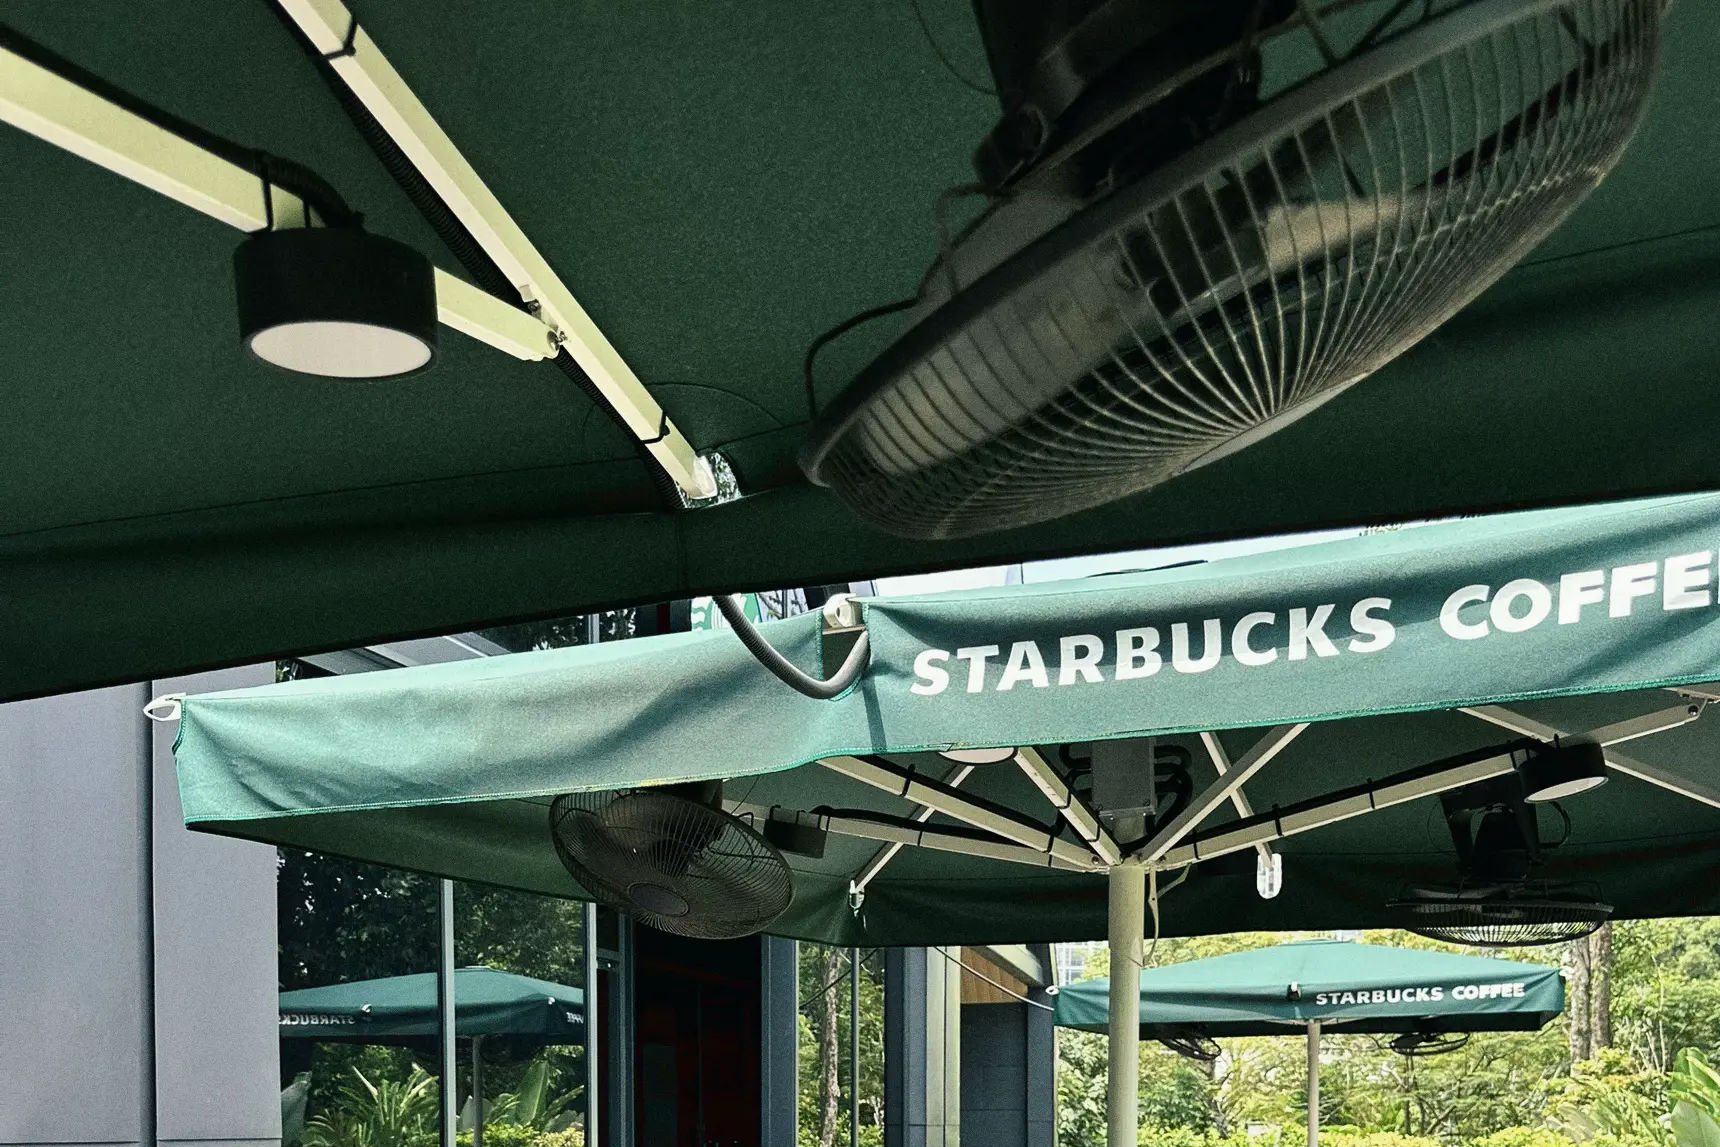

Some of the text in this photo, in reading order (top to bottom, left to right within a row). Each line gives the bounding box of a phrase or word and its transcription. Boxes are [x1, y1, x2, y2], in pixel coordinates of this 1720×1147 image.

[910, 550, 1720, 695] STARBUCKS COFFE
[1315, 982, 1526, 1006] STARBUCKS COFFEE
